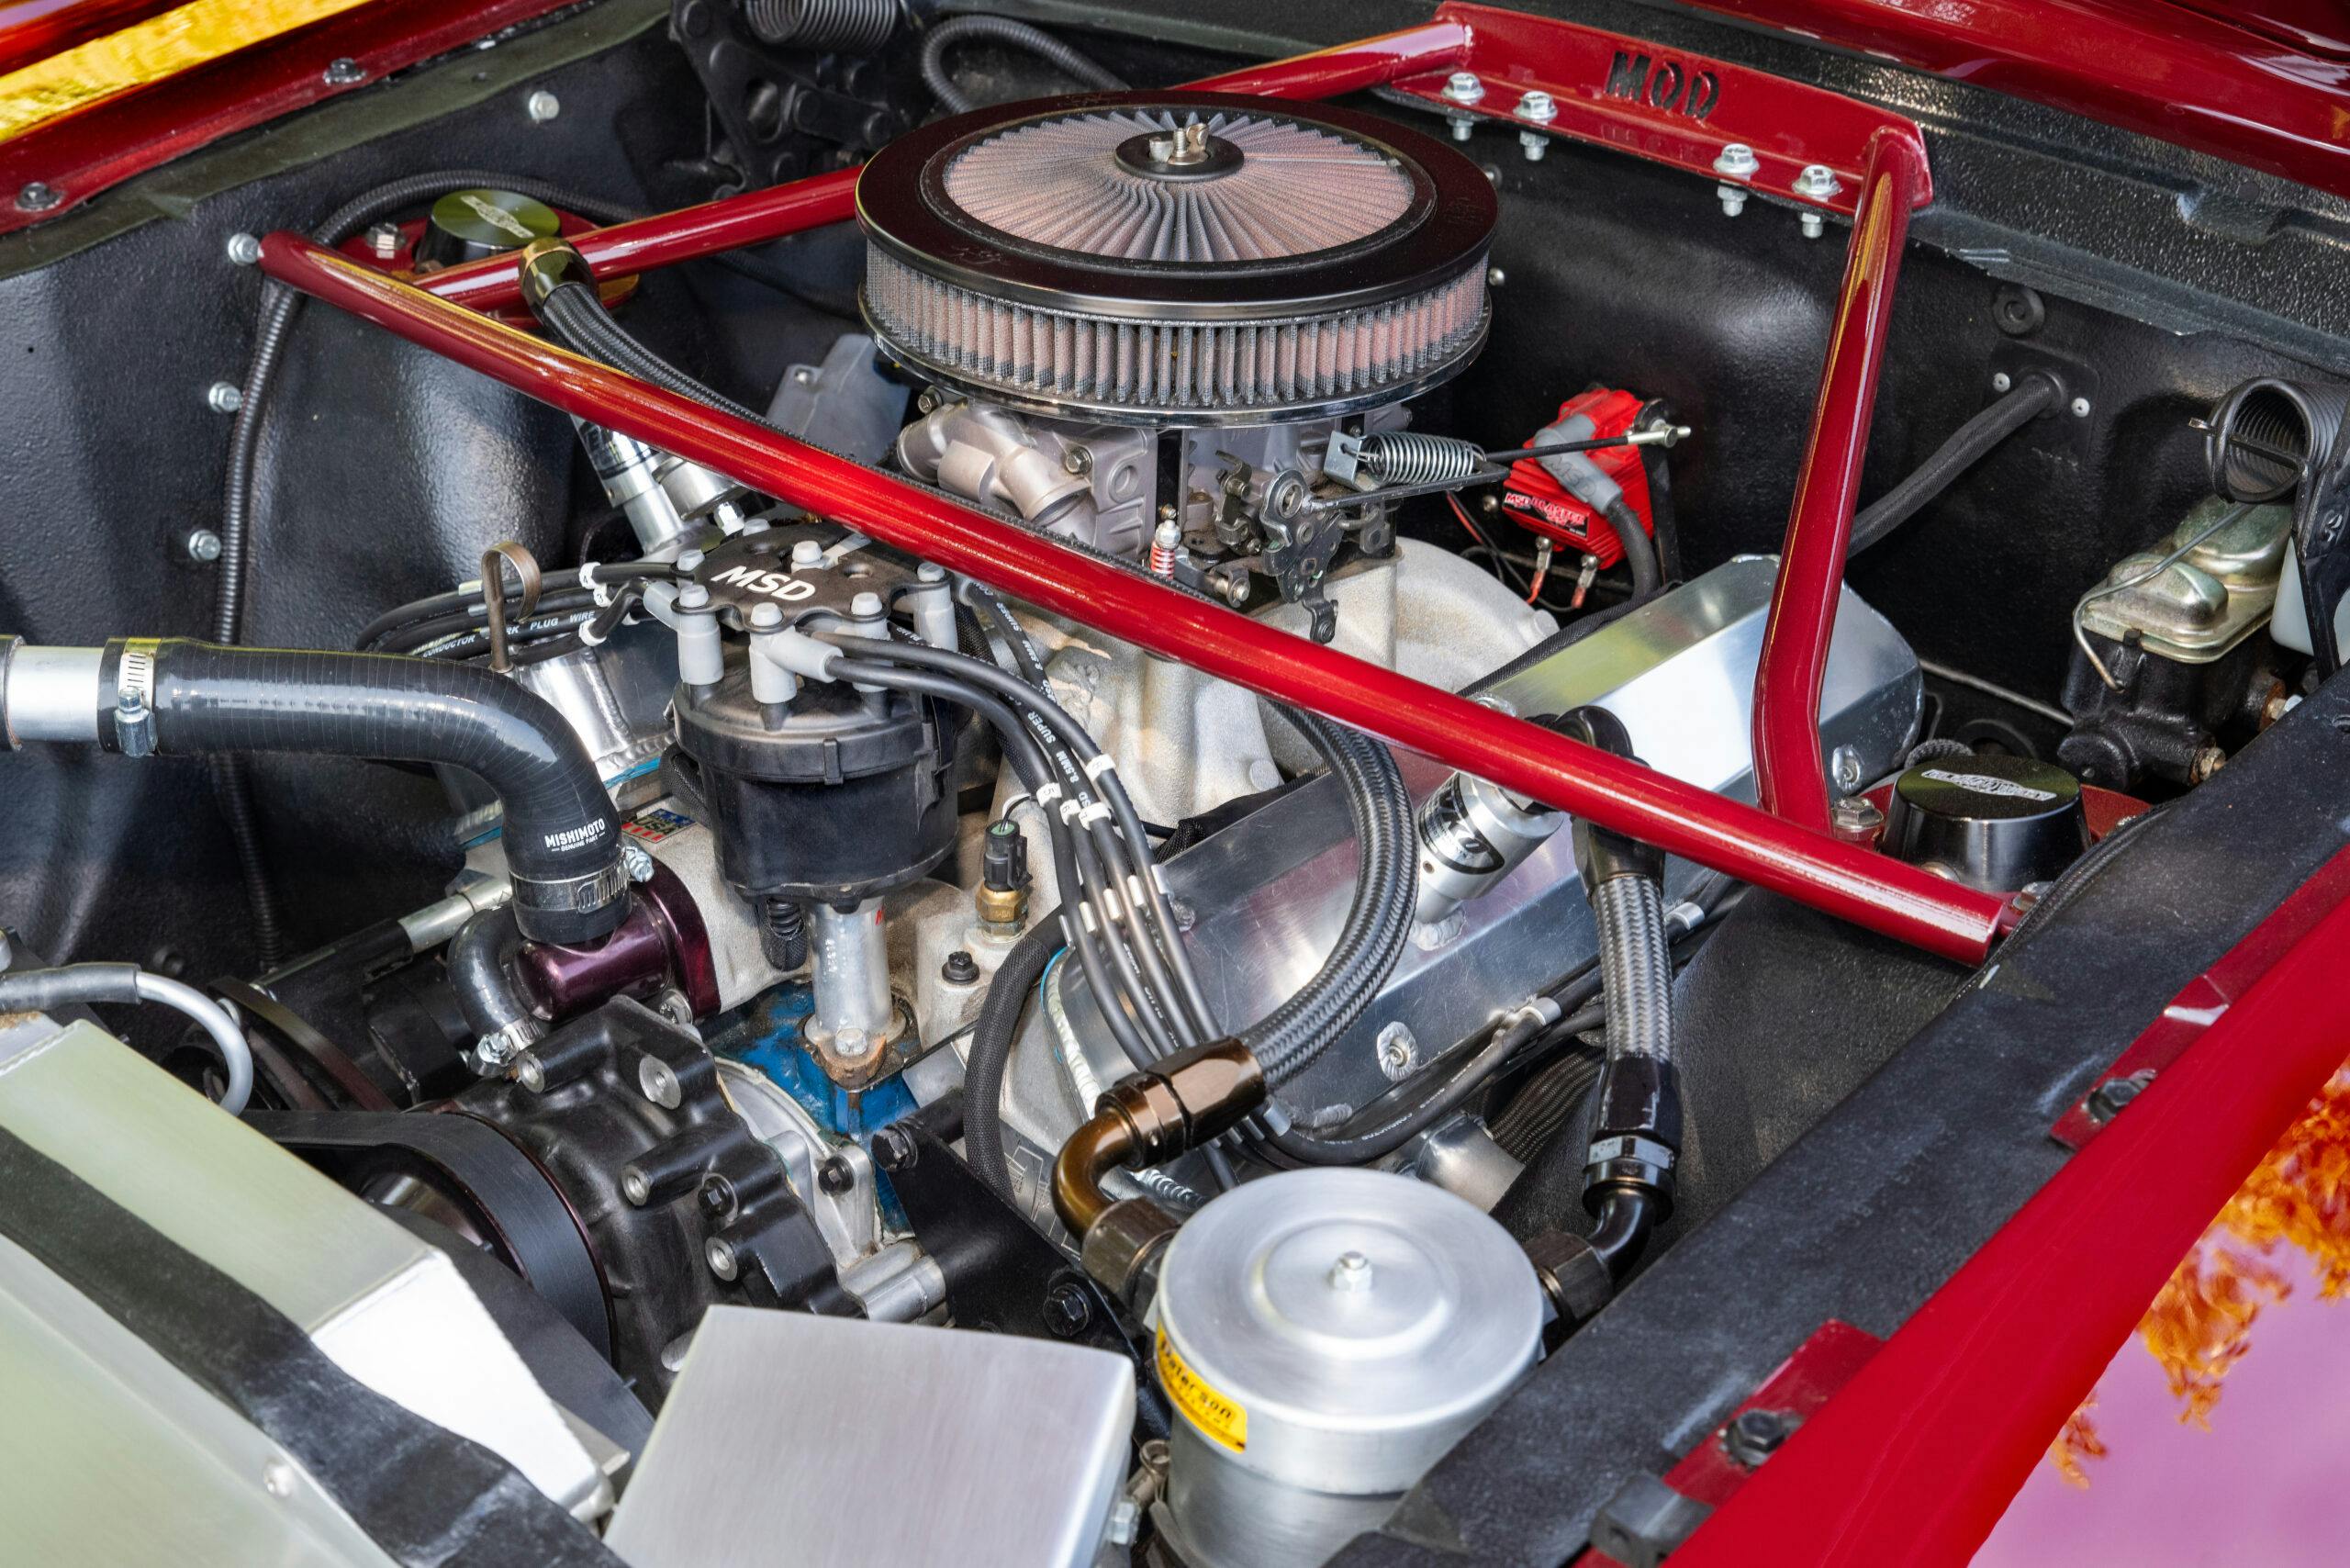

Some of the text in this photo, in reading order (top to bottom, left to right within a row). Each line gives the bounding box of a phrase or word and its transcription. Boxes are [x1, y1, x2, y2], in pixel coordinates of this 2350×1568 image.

[1606, 50, 1719, 119] MOD
[711, 566, 816, 601] MSD
[530, 617, 560, 631] PLUG
[569, 610, 596, 624] WIRE
[996, 601, 1023, 633] SUPER
[1027, 711, 1091, 809] SD 8.5MM SUPER
[544, 817, 606, 848] MISHIMOTO
[585, 834, 599, 845] PART
